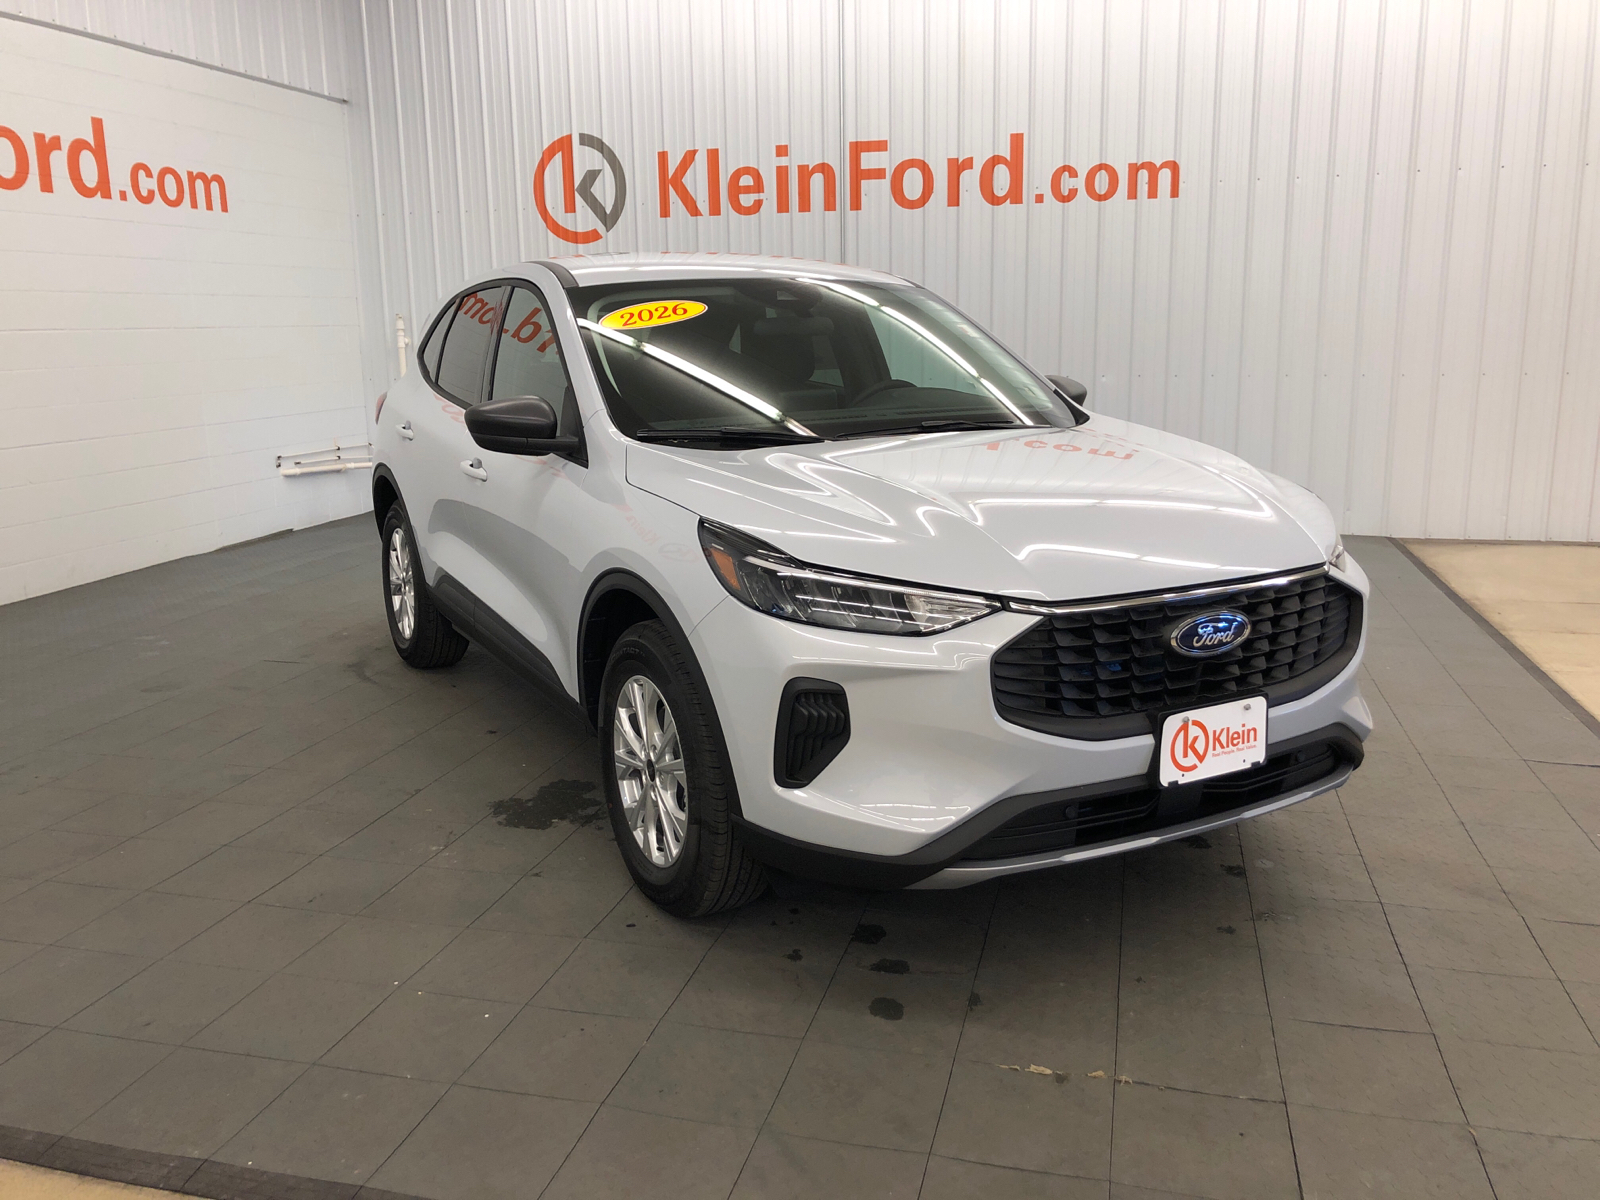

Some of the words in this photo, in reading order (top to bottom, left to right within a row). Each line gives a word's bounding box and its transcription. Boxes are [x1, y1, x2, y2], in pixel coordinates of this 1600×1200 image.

[657, 132, 1181, 219] KleinFord.com
[619, 302, 689, 327] 2026
[1192, 621, 1239, 648] Ford
[1212, 723, 1258, 752] Klein
